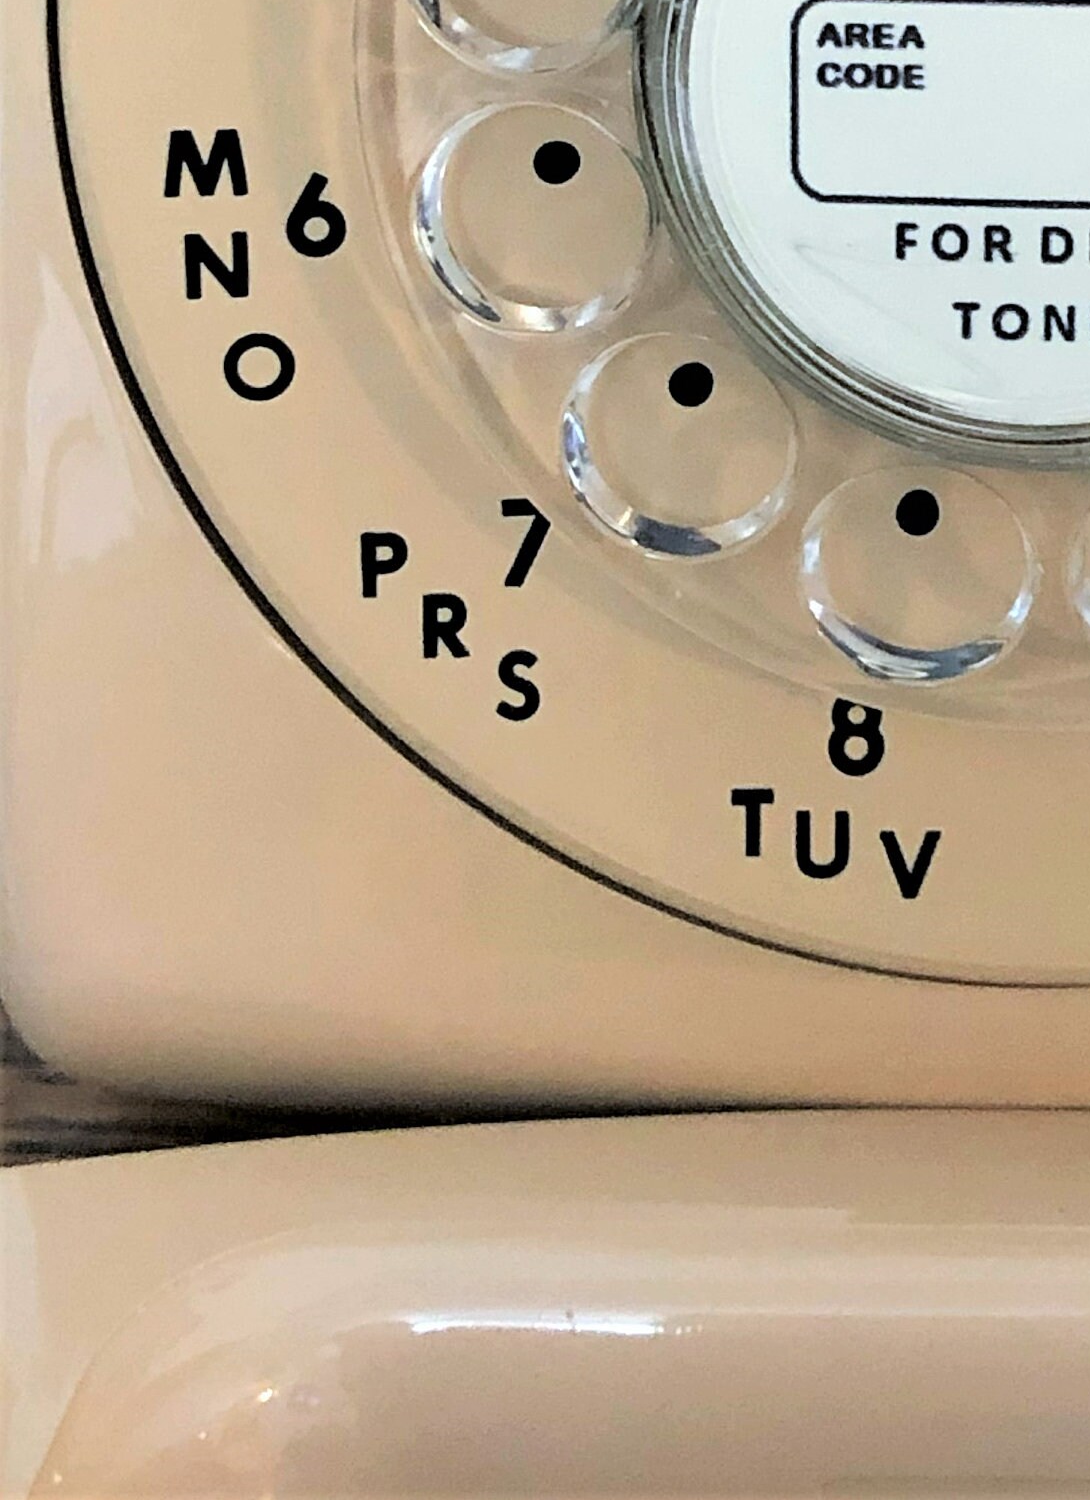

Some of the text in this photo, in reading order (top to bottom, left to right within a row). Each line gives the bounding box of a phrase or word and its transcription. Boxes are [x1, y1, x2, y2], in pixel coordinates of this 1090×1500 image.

[816, 21, 926, 50] AREA
[815, 61, 926, 90] CODE
[284, 171, 348, 259] 6
[894, 221, 1014, 264] FOR
[500, 497, 552, 589] 7
[826, 696, 886, 778] 8
